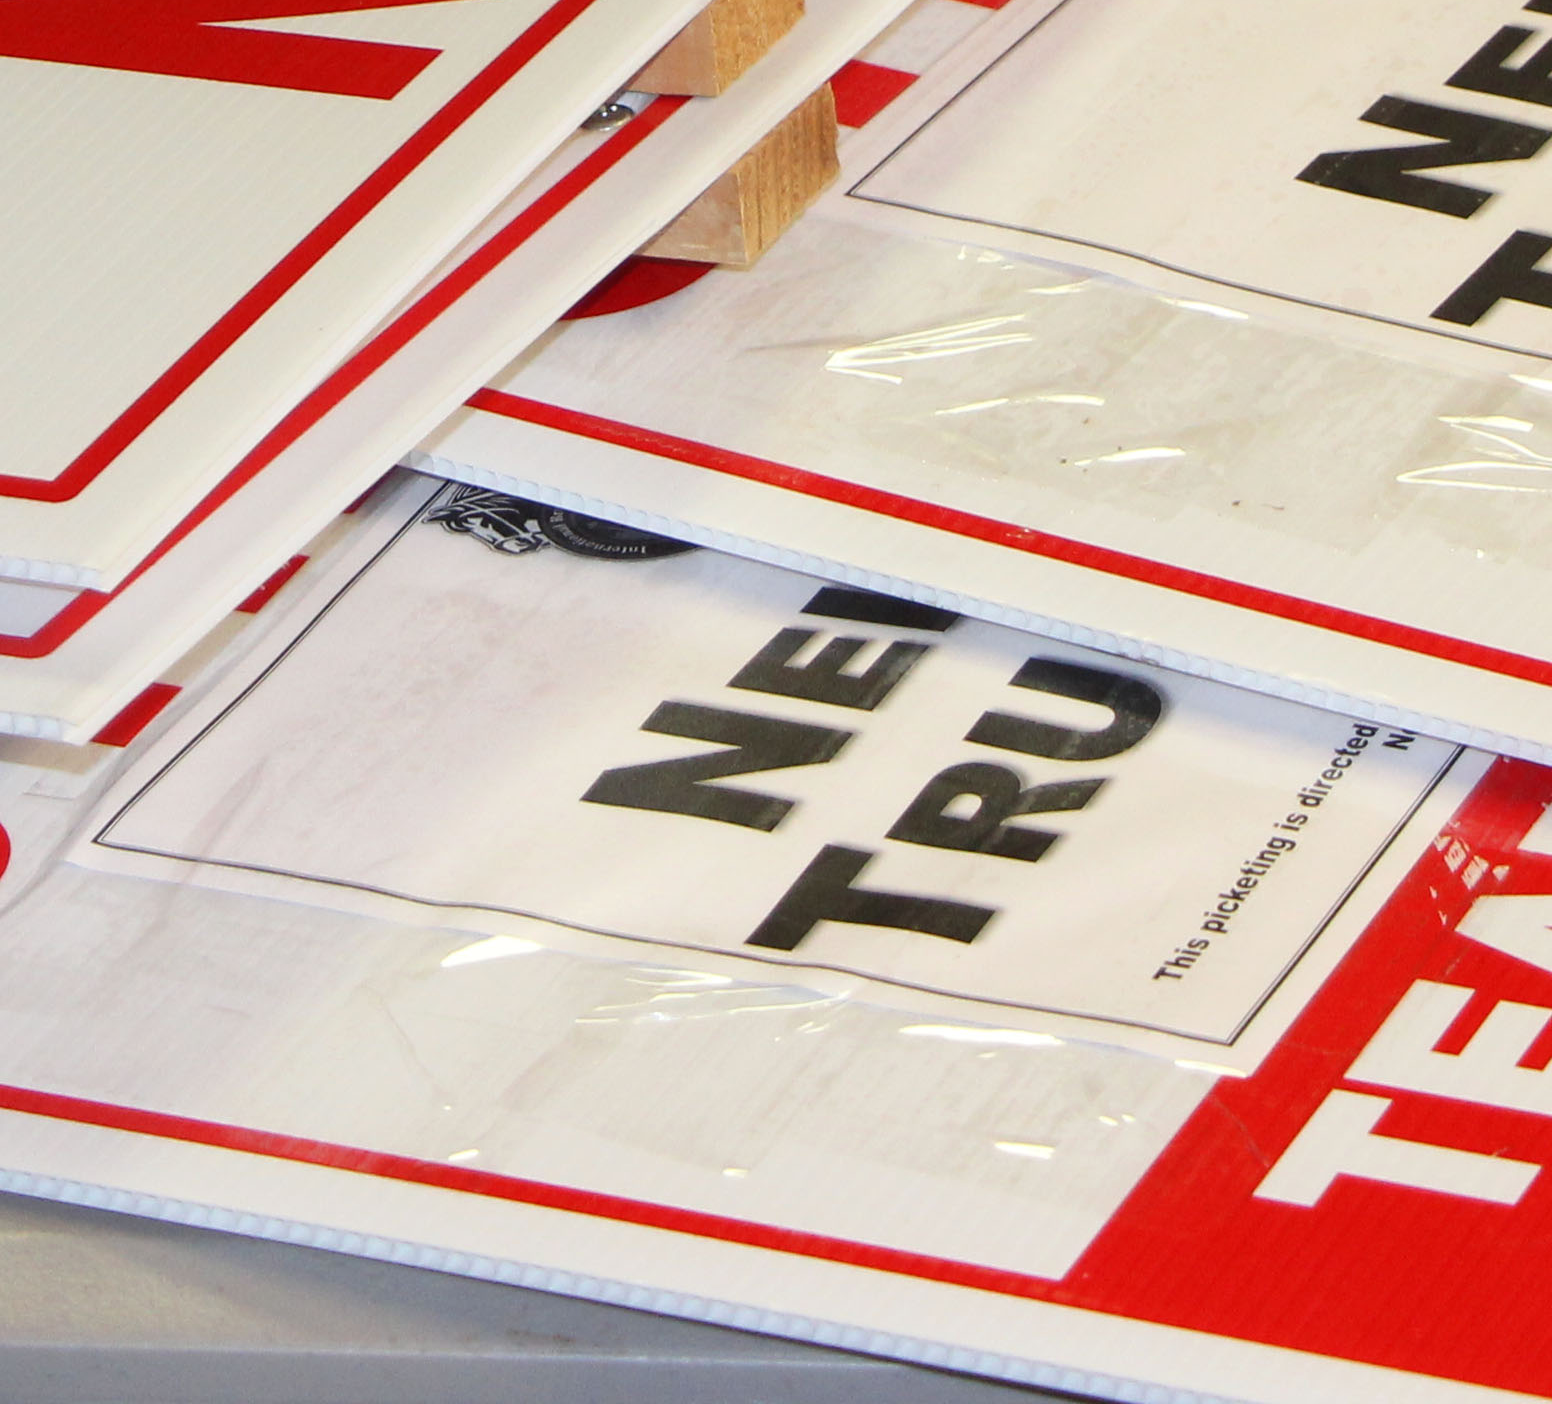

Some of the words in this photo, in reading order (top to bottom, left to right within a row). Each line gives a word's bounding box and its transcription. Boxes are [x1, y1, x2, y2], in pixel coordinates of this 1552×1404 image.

[1151, 936, 1211, 982] This
[1199, 835, 1298, 935] picketing
[1273, 811, 1310, 833] is
[1296, 722, 1380, 809] directed
